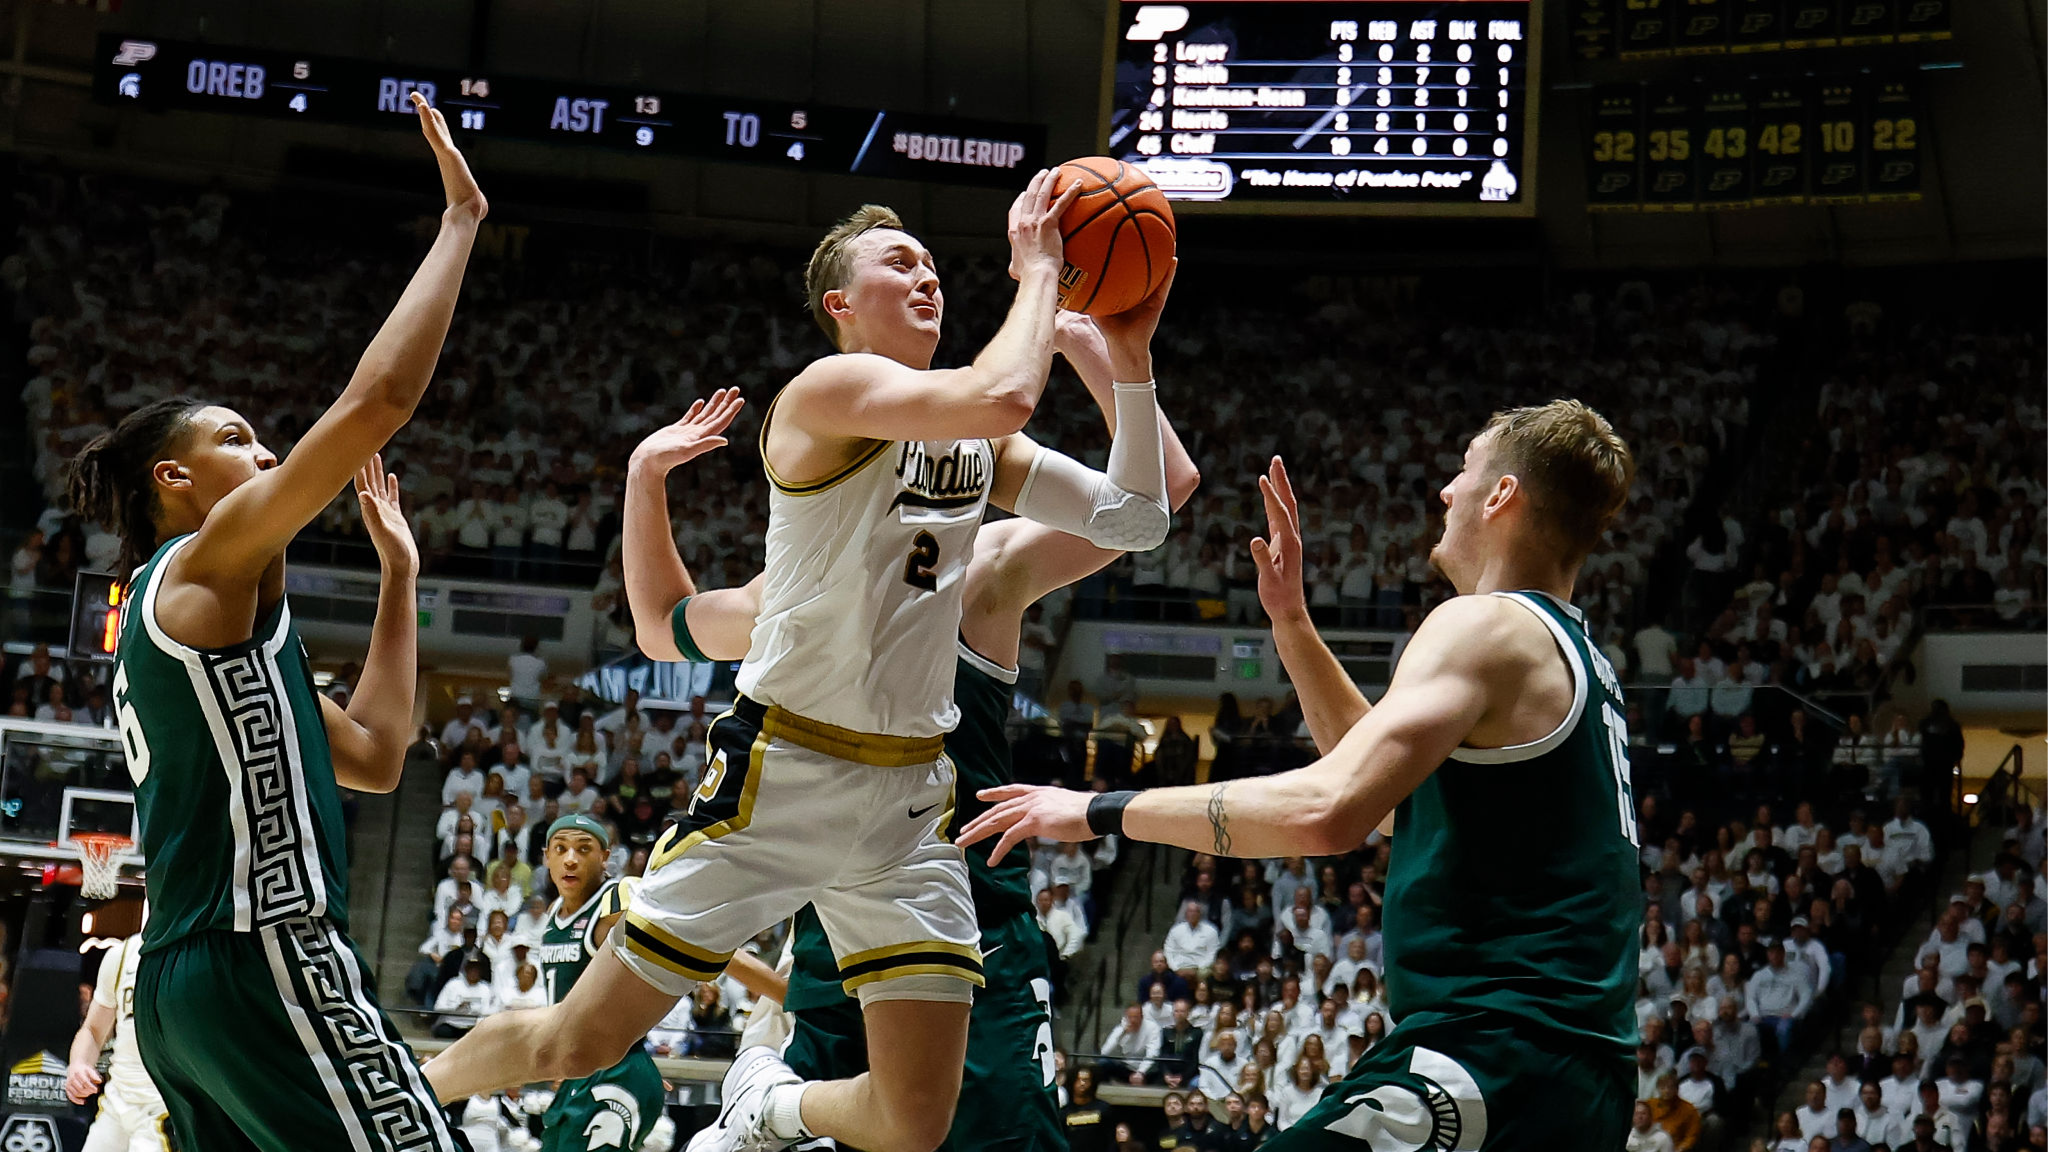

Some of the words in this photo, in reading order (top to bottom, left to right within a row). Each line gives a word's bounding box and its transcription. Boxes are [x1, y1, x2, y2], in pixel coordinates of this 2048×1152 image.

[1331, 21, 1357, 40] PTS
[1410, 21, 1436, 39] AST
[1154, 44, 1167, 62] 2
[1176, 41, 1228, 66] Loyer
[1339, 44, 1352, 62] 3
[1379, 44, 1393, 62] 0
[1417, 45, 1430, 62] 2
[1457, 45, 1471, 62] 0
[1498, 45, 1511, 62] 0
[186, 60, 265, 99] OREB
[293, 62, 309, 79] 5
[1153, 66, 1166, 85] 3
[1174, 63, 1228, 83] Smith
[1338, 67, 1351, 85] 2
[1378, 68, 1391, 85] 3
[1417, 68, 1429, 85] 7
[1456, 68, 1470, 85] 0
[1499, 68, 1508, 85] 1
[378, 78, 436, 113] REB
[460, 79, 489, 98] 14
[1151, 88, 1164, 106] 4
[1377, 89, 1390, 106] 3
[1415, 88, 1428, 106] 2
[1458, 89, 1466, 106] 1
[1499, 90, 1507, 107] 1
[289, 94, 307, 112] 4
[635, 97, 660, 115] 13
[461, 109, 485, 130] 11
[550, 96, 609, 134] AST
[791, 112, 807, 129] 5
[1140, 111, 1162, 130] 24
[1172, 109, 1228, 129] Harris
[1334, 112, 1348, 131] 2
[1376, 113, 1389, 131] 2
[1416, 114, 1425, 131] 1
[1454, 114, 1467, 131] 0
[1497, 114, 1506, 131] 1
[636, 127, 654, 146] 9
[723, 112, 760, 148] TO
[1759, 122, 1801, 155] 42
[1820, 121, 1856, 152] 10
[1873, 118, 1916, 151] 22
[787, 141, 804, 160] 4
[892, 132, 1025, 169] #BOILERUP
[1137, 136, 1161, 154] 45
[1171, 133, 1215, 153] Cluff
[1374, 138, 1388, 155] 4
[1412, 138, 1426, 156] 0
[1453, 138, 1467, 156] 0
[1494, 139, 1507, 156] 0
[1594, 131, 1636, 162] 32
[1649, 129, 1690, 162] 35
[1704, 127, 1747, 159] 43
[1283, 170, 1333, 186] Home
[1335, 170, 1358, 186] of
[1357, 170, 1419, 187] Purdue
[903, 529, 940, 592] 2
[9, 1074, 67, 1090] PURDUE
[8, 1088, 68, 1101] FEDERAL
